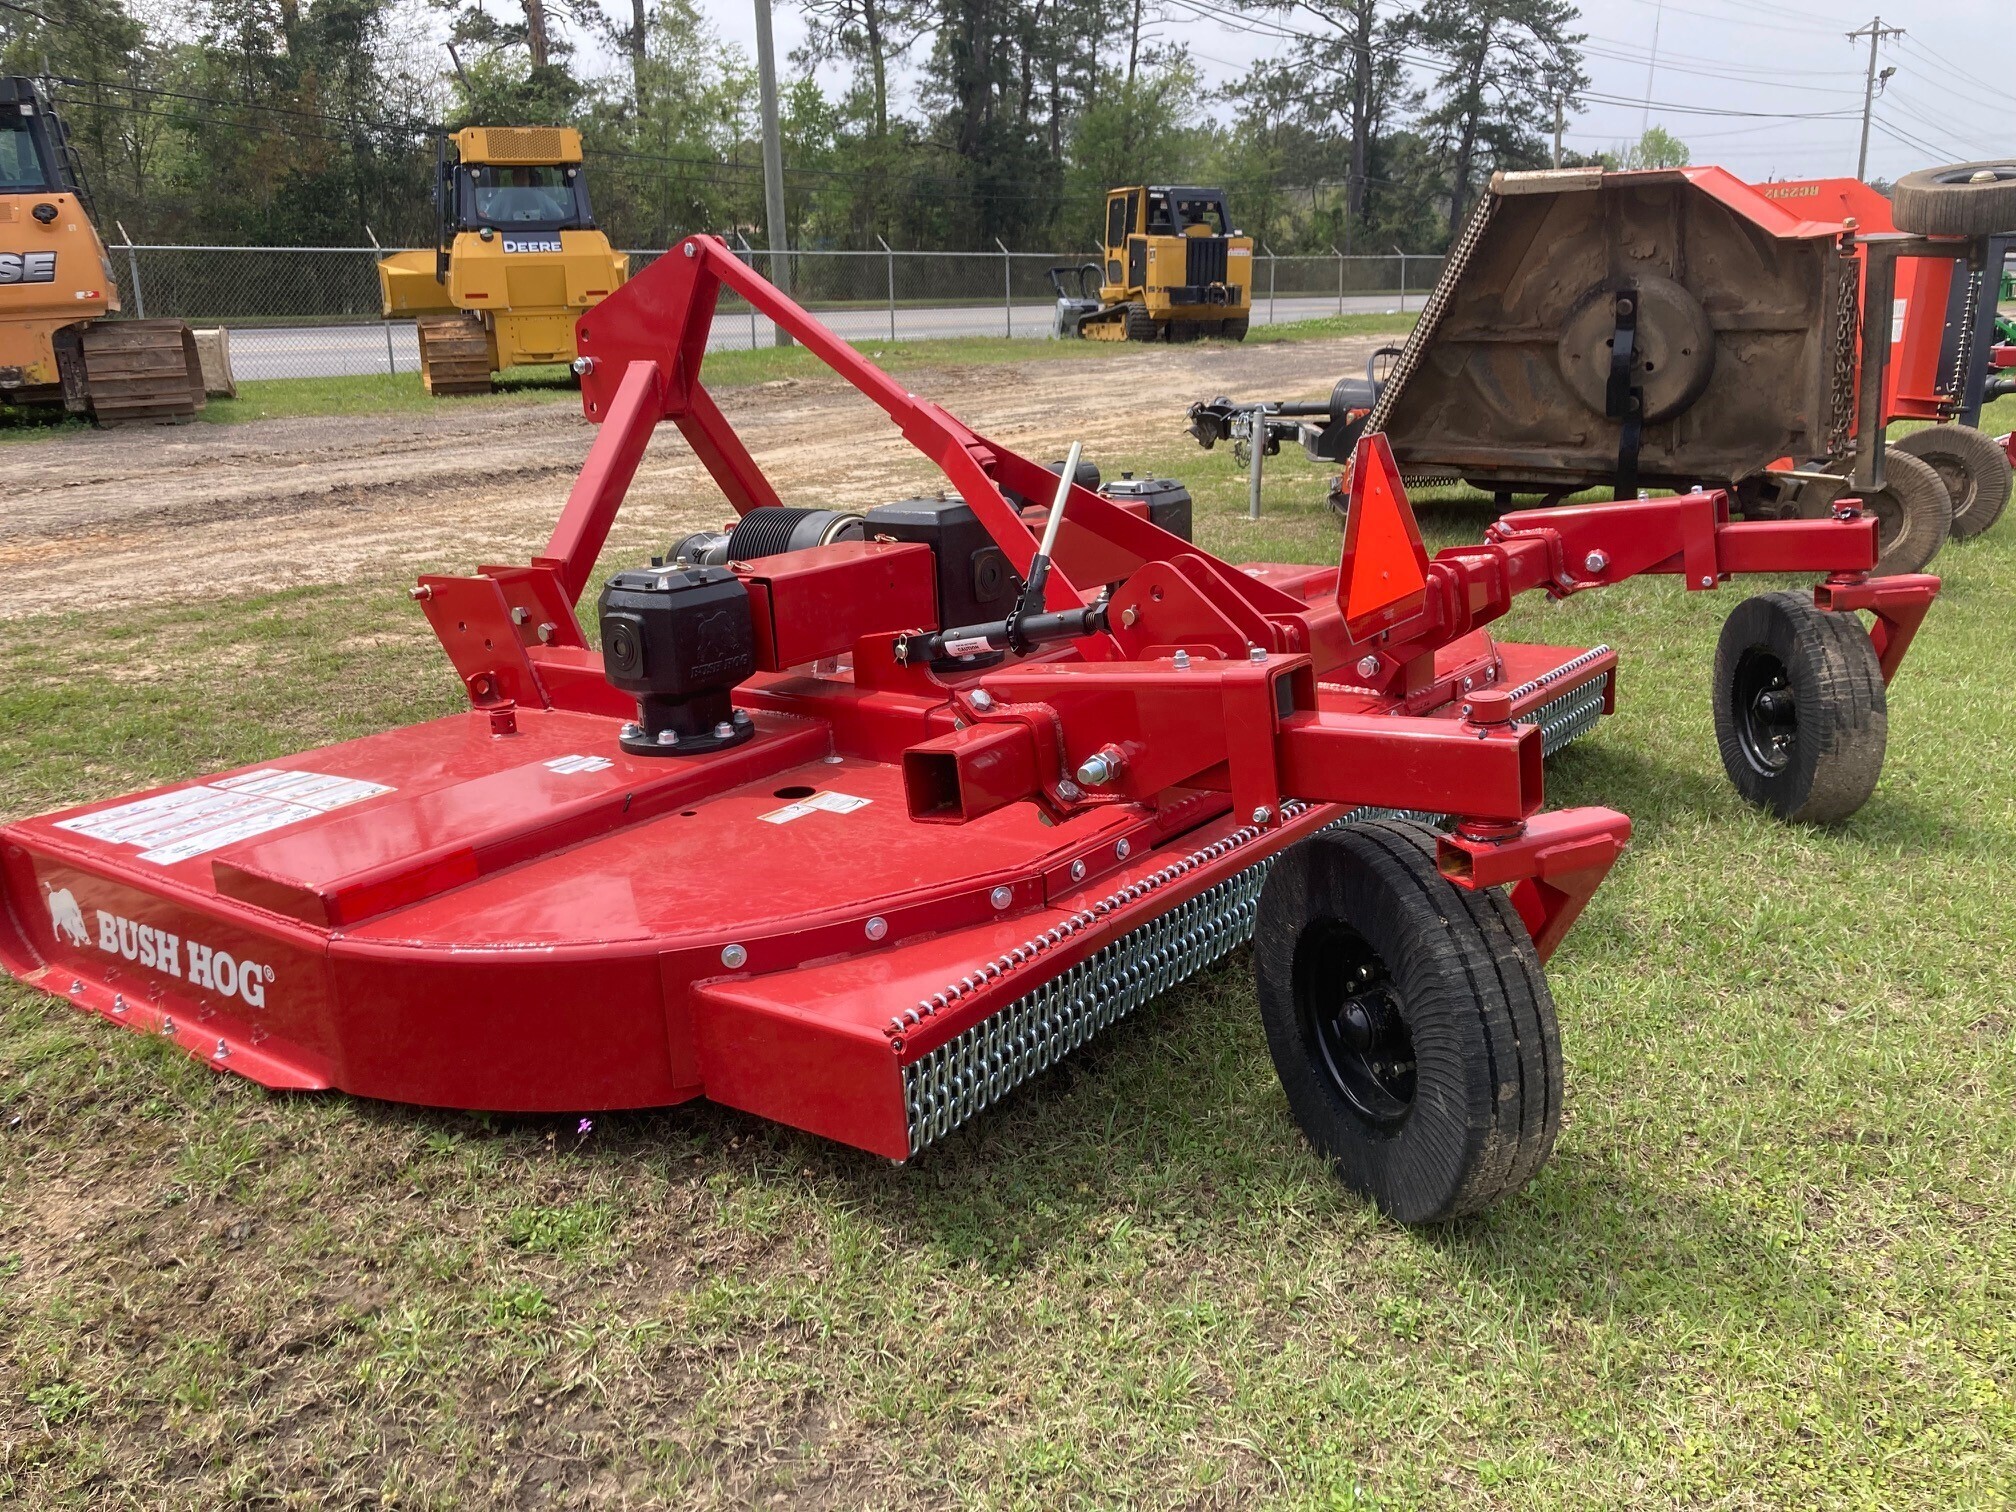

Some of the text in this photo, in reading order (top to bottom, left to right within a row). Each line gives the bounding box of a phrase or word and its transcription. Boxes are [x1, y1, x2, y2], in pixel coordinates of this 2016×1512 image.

[503, 240, 562, 253] DEERE
[0, 252, 56, 283] SE
[97, 909, 181, 978] BUSH
